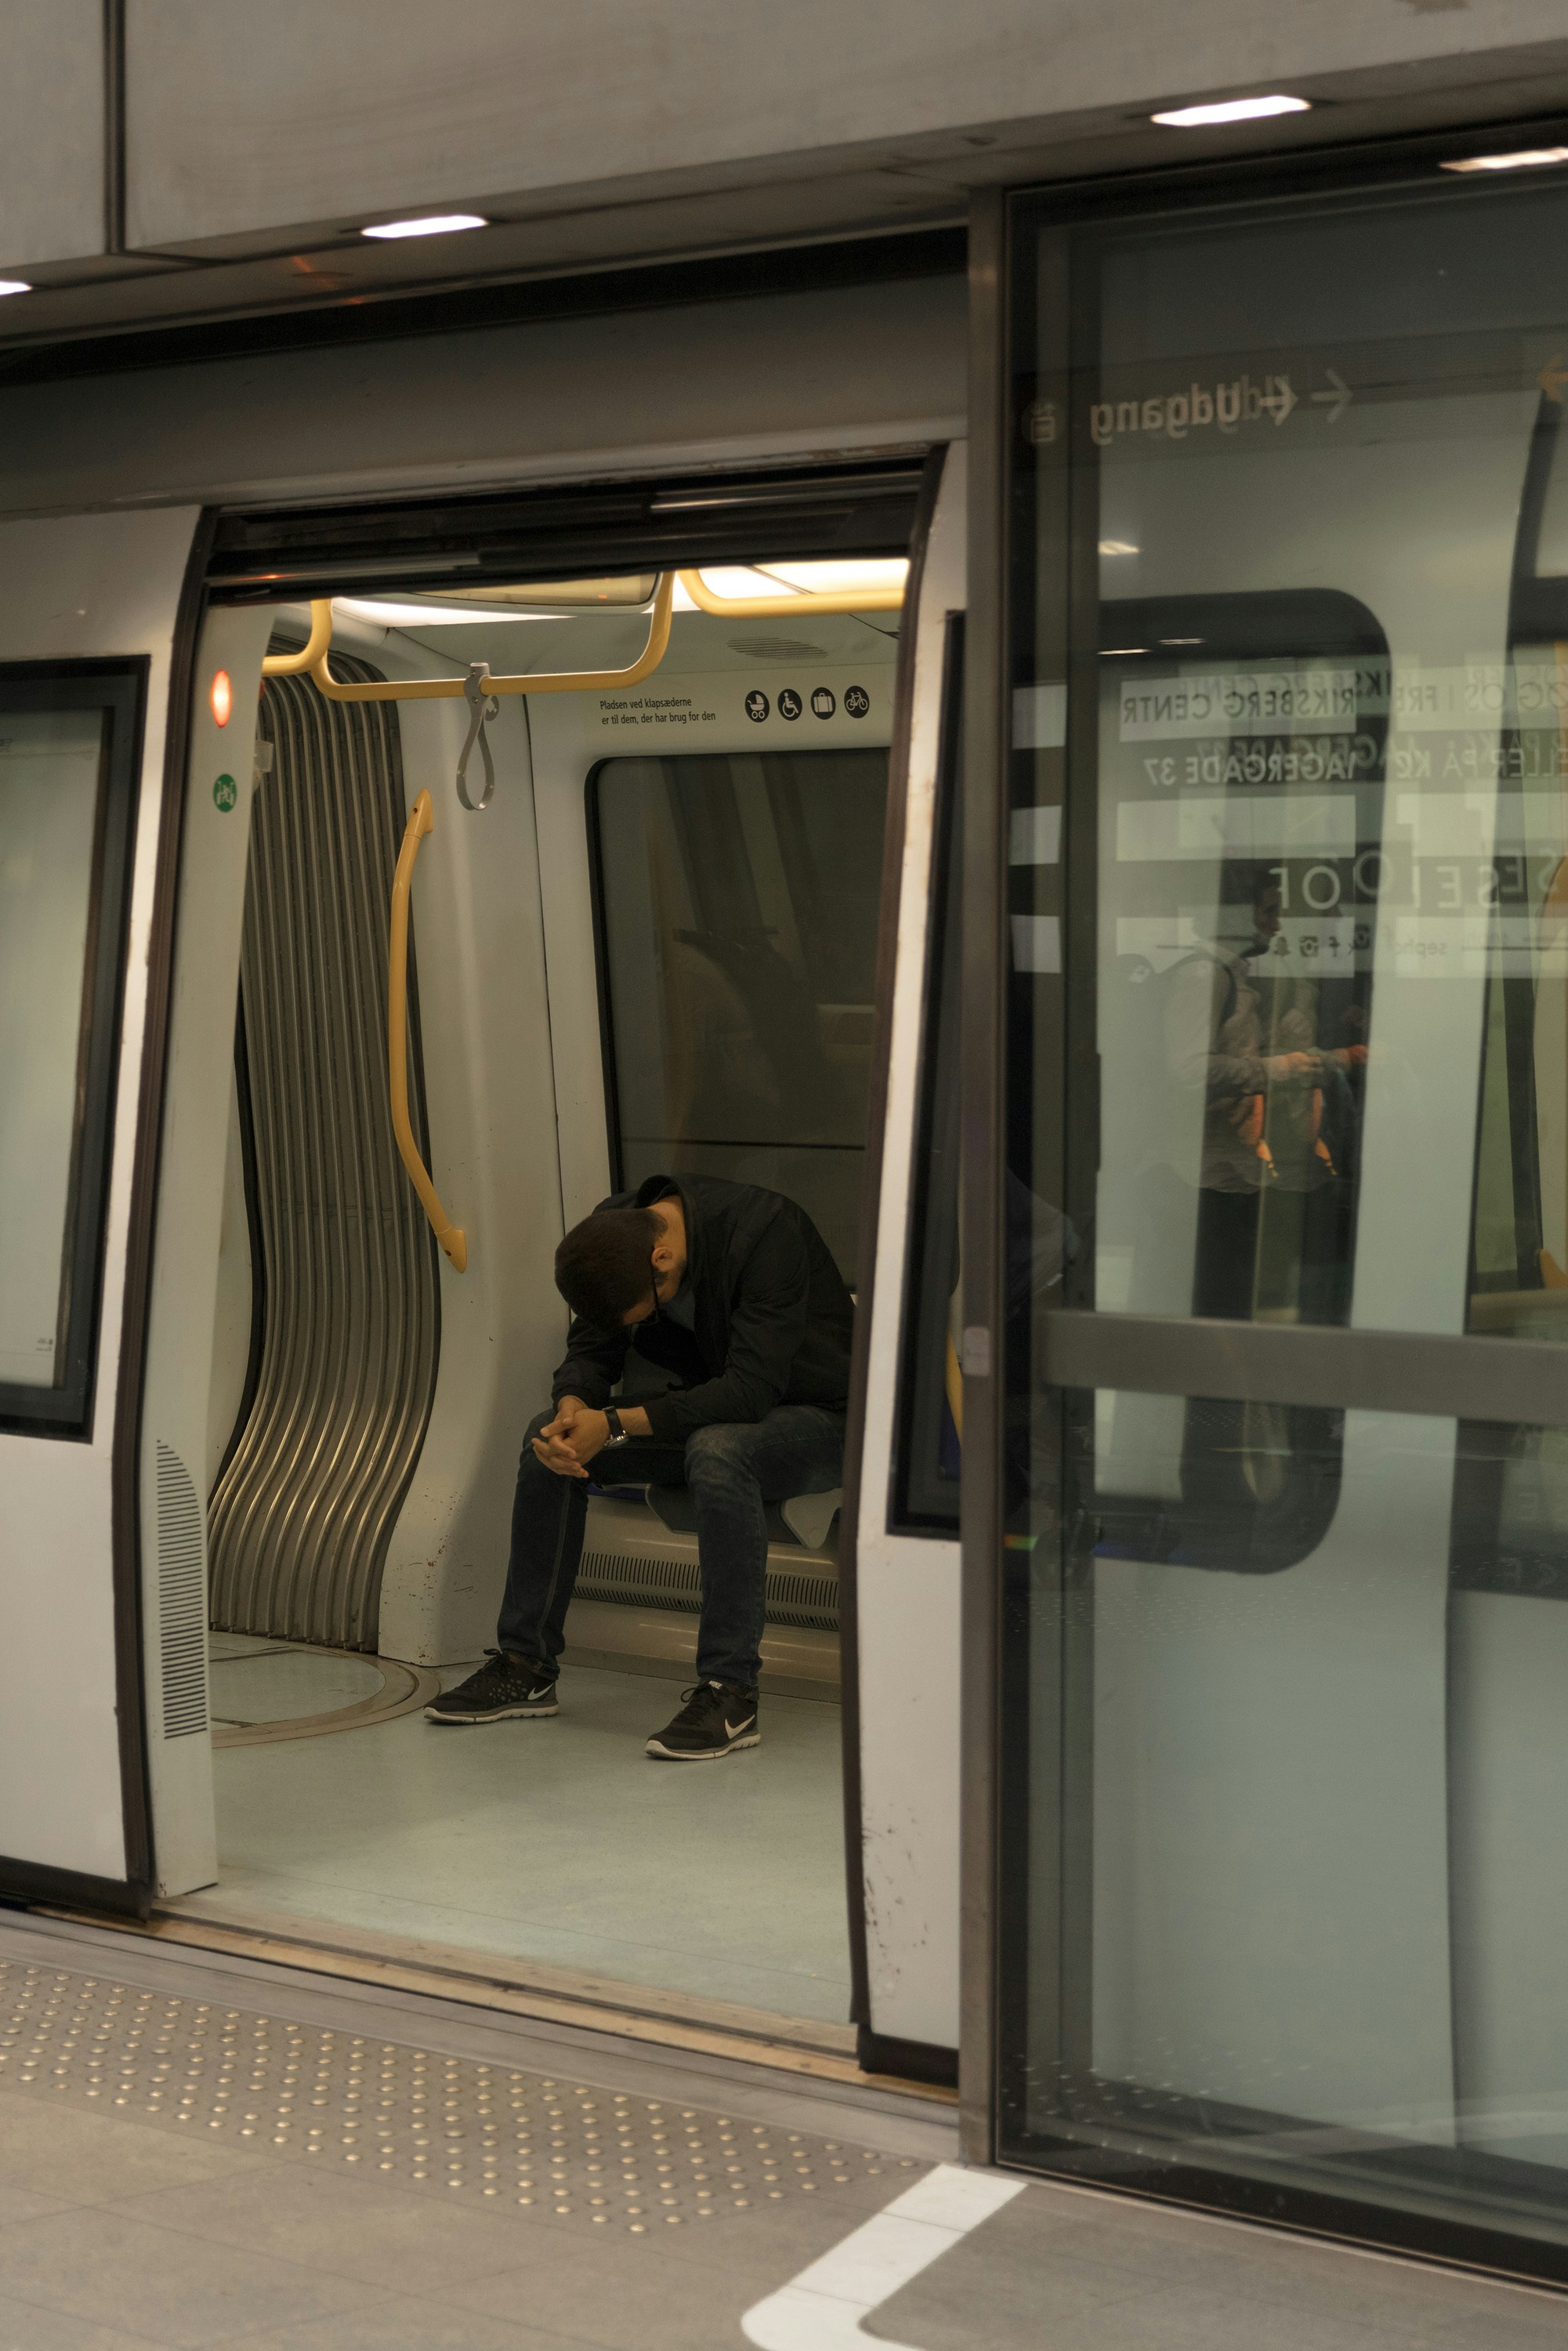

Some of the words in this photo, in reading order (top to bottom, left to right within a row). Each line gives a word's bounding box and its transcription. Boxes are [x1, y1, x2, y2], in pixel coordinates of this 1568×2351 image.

[599, 700, 628, 710] Pladsen
[629, 699, 643, 708] ved
[644, 697, 692, 710] klapsæderne
[621, 715, 639, 725] dem,
[641, 713, 653, 723] der
[655, 713, 667, 723] har
[669, 712, 687, 724] brug
[689, 712, 699, 721] for
[702, 711, 716, 720] den
